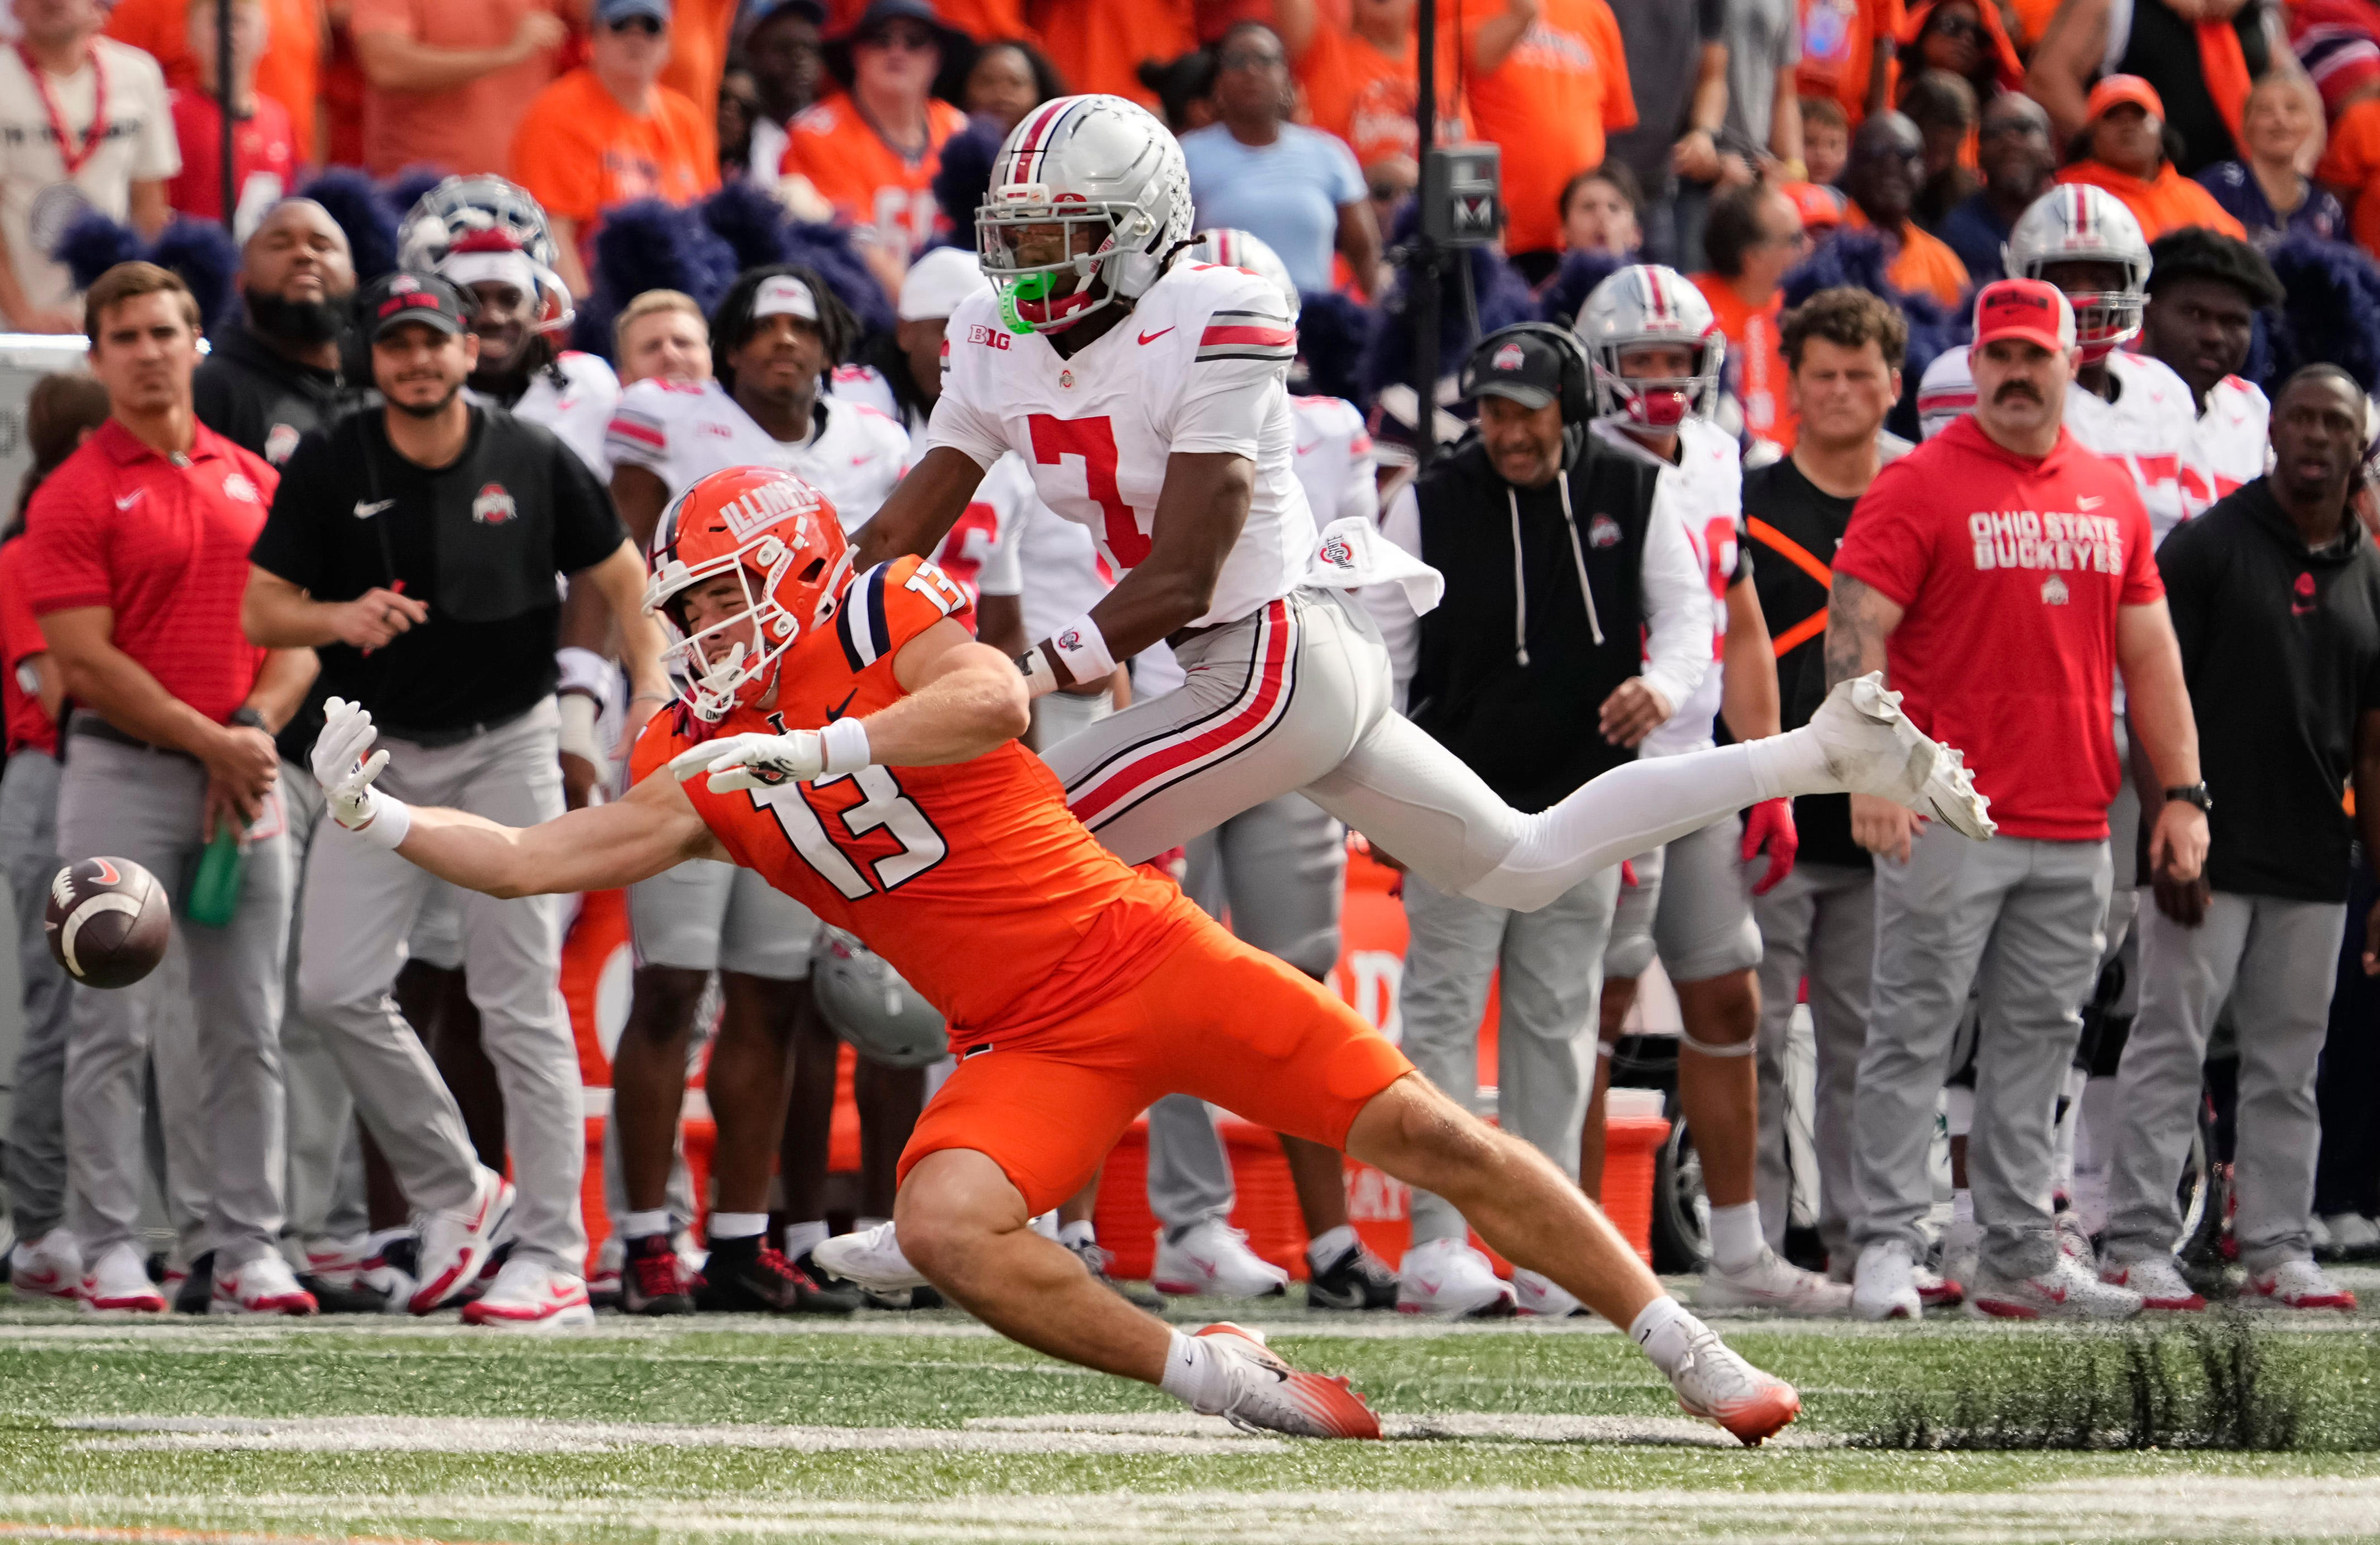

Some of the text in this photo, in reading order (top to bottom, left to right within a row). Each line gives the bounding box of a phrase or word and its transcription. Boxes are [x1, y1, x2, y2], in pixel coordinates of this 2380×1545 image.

[968, 324, 1011, 351] BIG
[1028, 414, 1152, 569] 7
[1968, 511, 2123, 545] OHIO STATE
[1974, 538, 2122, 576] BUCKEYES
[903, 562, 966, 617] 13
[746, 764, 949, 902] 13
